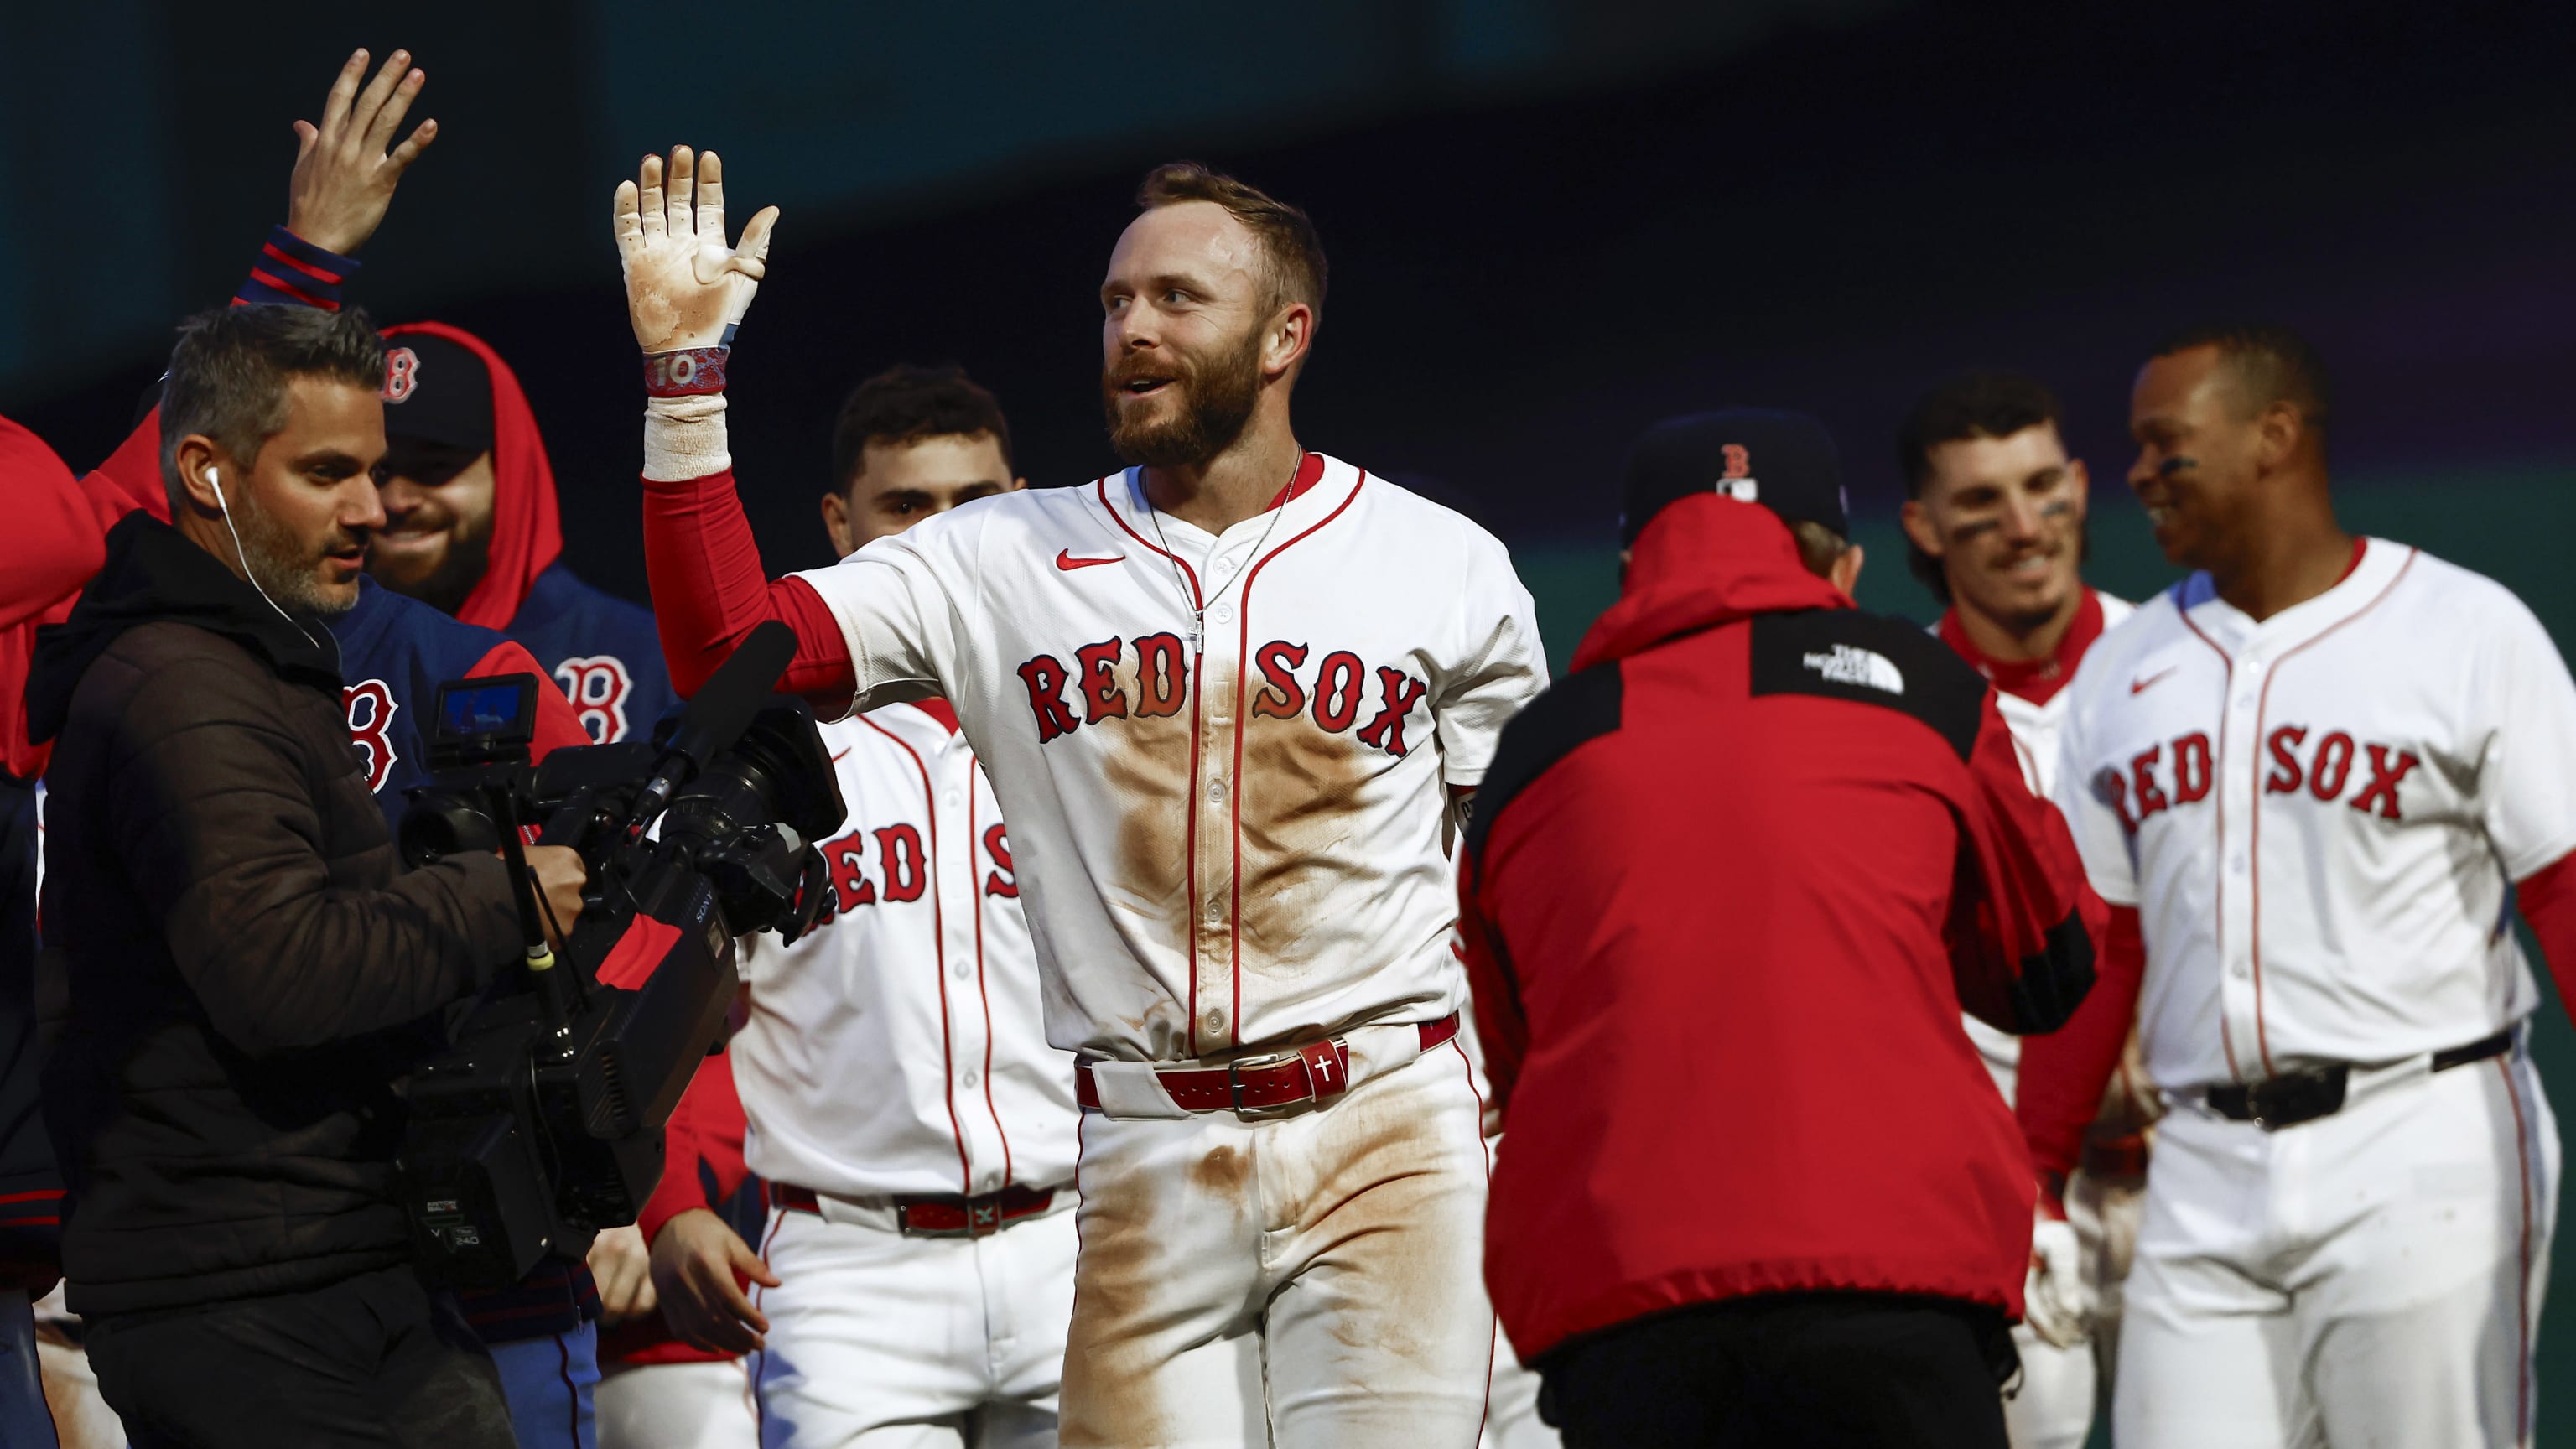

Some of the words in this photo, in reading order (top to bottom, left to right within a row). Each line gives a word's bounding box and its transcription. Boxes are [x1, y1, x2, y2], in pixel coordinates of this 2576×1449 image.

[383, 347, 420, 403] B
[653, 355, 696, 387] 10
[1721, 444, 1750, 479] B
[555, 655, 633, 745] B
[1016, 631, 1190, 745] RED
[1252, 639, 1427, 758] SOX
[2267, 724, 2421, 820] SOX
[696, 889, 713, 923] SONY
